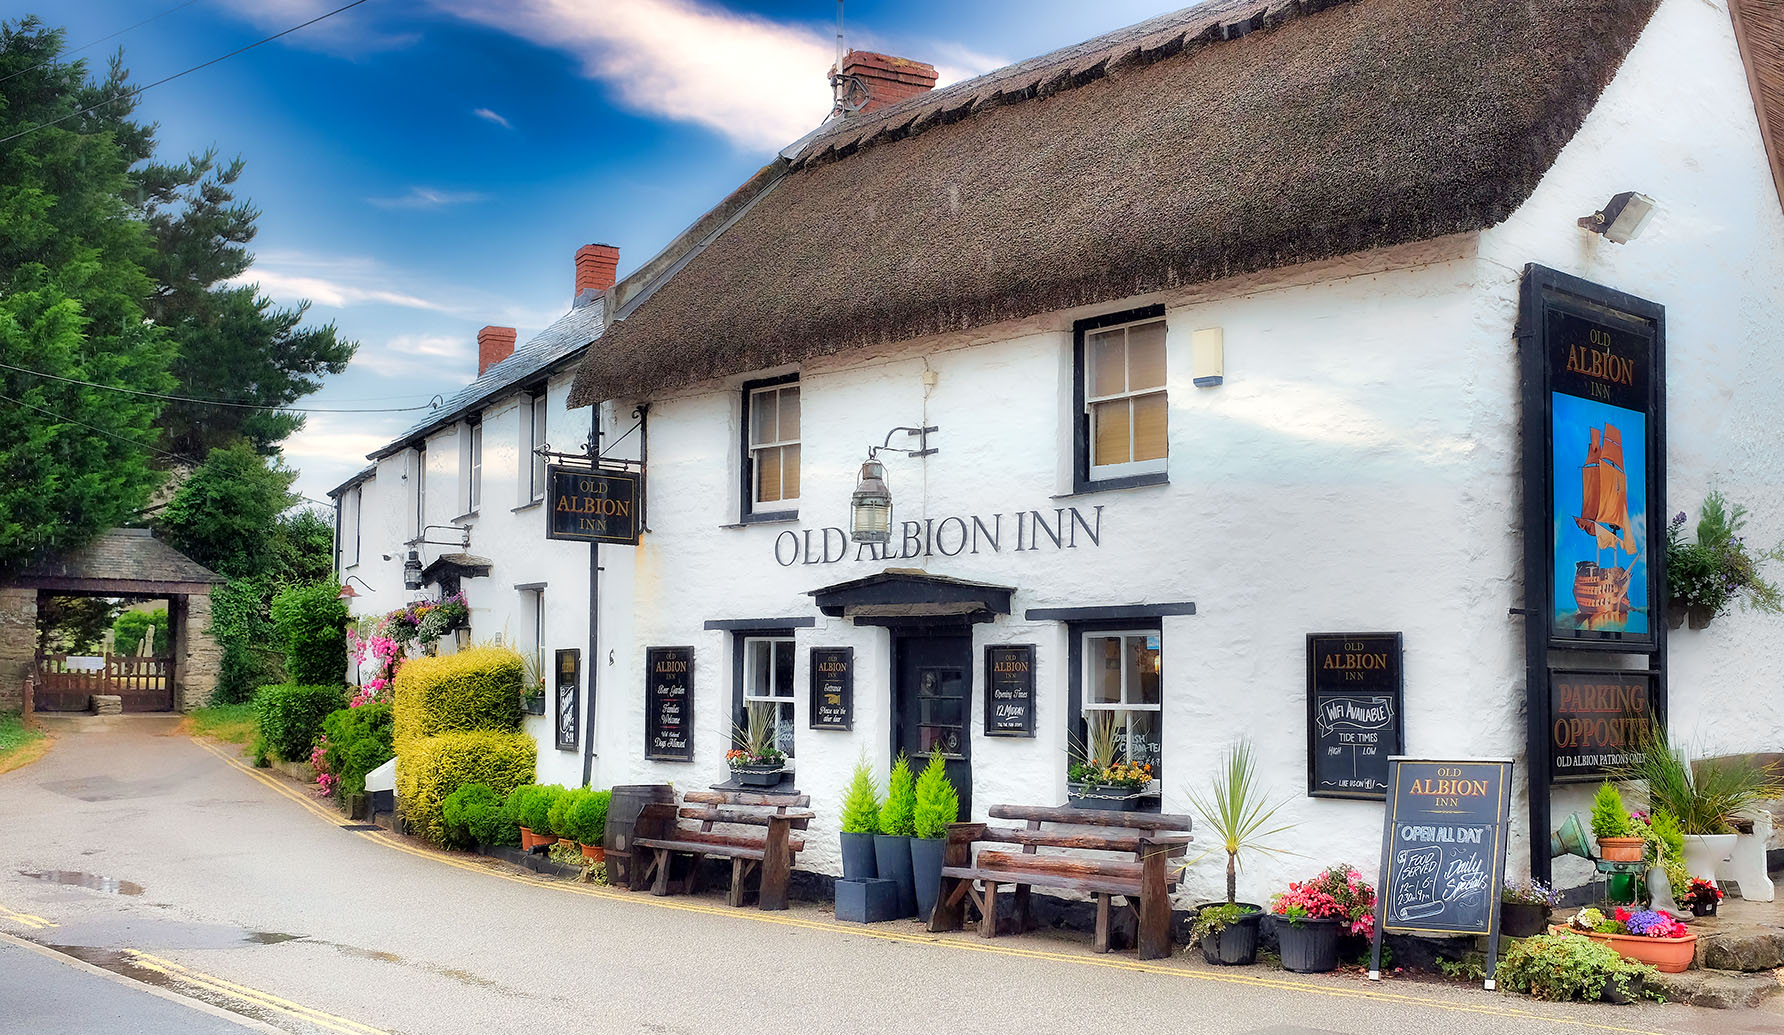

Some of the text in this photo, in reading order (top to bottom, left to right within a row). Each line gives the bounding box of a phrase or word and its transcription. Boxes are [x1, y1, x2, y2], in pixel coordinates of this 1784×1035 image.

[1590, 328, 1611, 347] OLD
[1567, 343, 1634, 386] ALBION
[1591, 381, 1611, 400] INN
[580, 480, 608, 494] OLD
[556, 495, 631, 518] ALBION
[580, 518, 607, 531] INN
[774, 527, 847, 567] OLD
[1014, 505, 1104, 552] INN
[1344, 642, 1365, 651] OLD
[655, 661, 687, 673] ALBION
[818, 662, 847, 672] ALBION
[994, 661, 1029, 672] ALBION
[1323, 653, 1388, 670] ALBION
[1345, 671, 1365, 681] INN
[669, 684, 685, 698] Garden
[824, 683, 841, 692] Entrance
[994, 687, 1029, 700] Opening Times
[1559, 684, 1645, 713] PARKING
[819, 706, 832, 715] Please
[1346, 701, 1386, 723] AVAILABLE
[661, 714, 680, 725] Welcome
[1339, 732, 1378, 743] TIDE TIMES
[1554, 718, 1649, 748] OPPOSITE
[654, 736, 667, 749] Dogs
[1362, 747, 1377, 756] LOW
[1556, 756, 1573, 768] OLD
[1573, 754, 1600, 766] ALBION
[1600, 753, 1629, 765] PATRONS
[1437, 767, 1462, 777] OLD
[1409, 779, 1489, 797] ALBION
[1435, 797, 1459, 808] INN
[1401, 826, 1484, 844] OPEN ALL DAY
[1408, 852, 1435, 867] FOOD
[1443, 852, 1483, 880] Daily
[1401, 861, 1438, 881] SERVED
[1441, 870, 1489, 902] Specials
